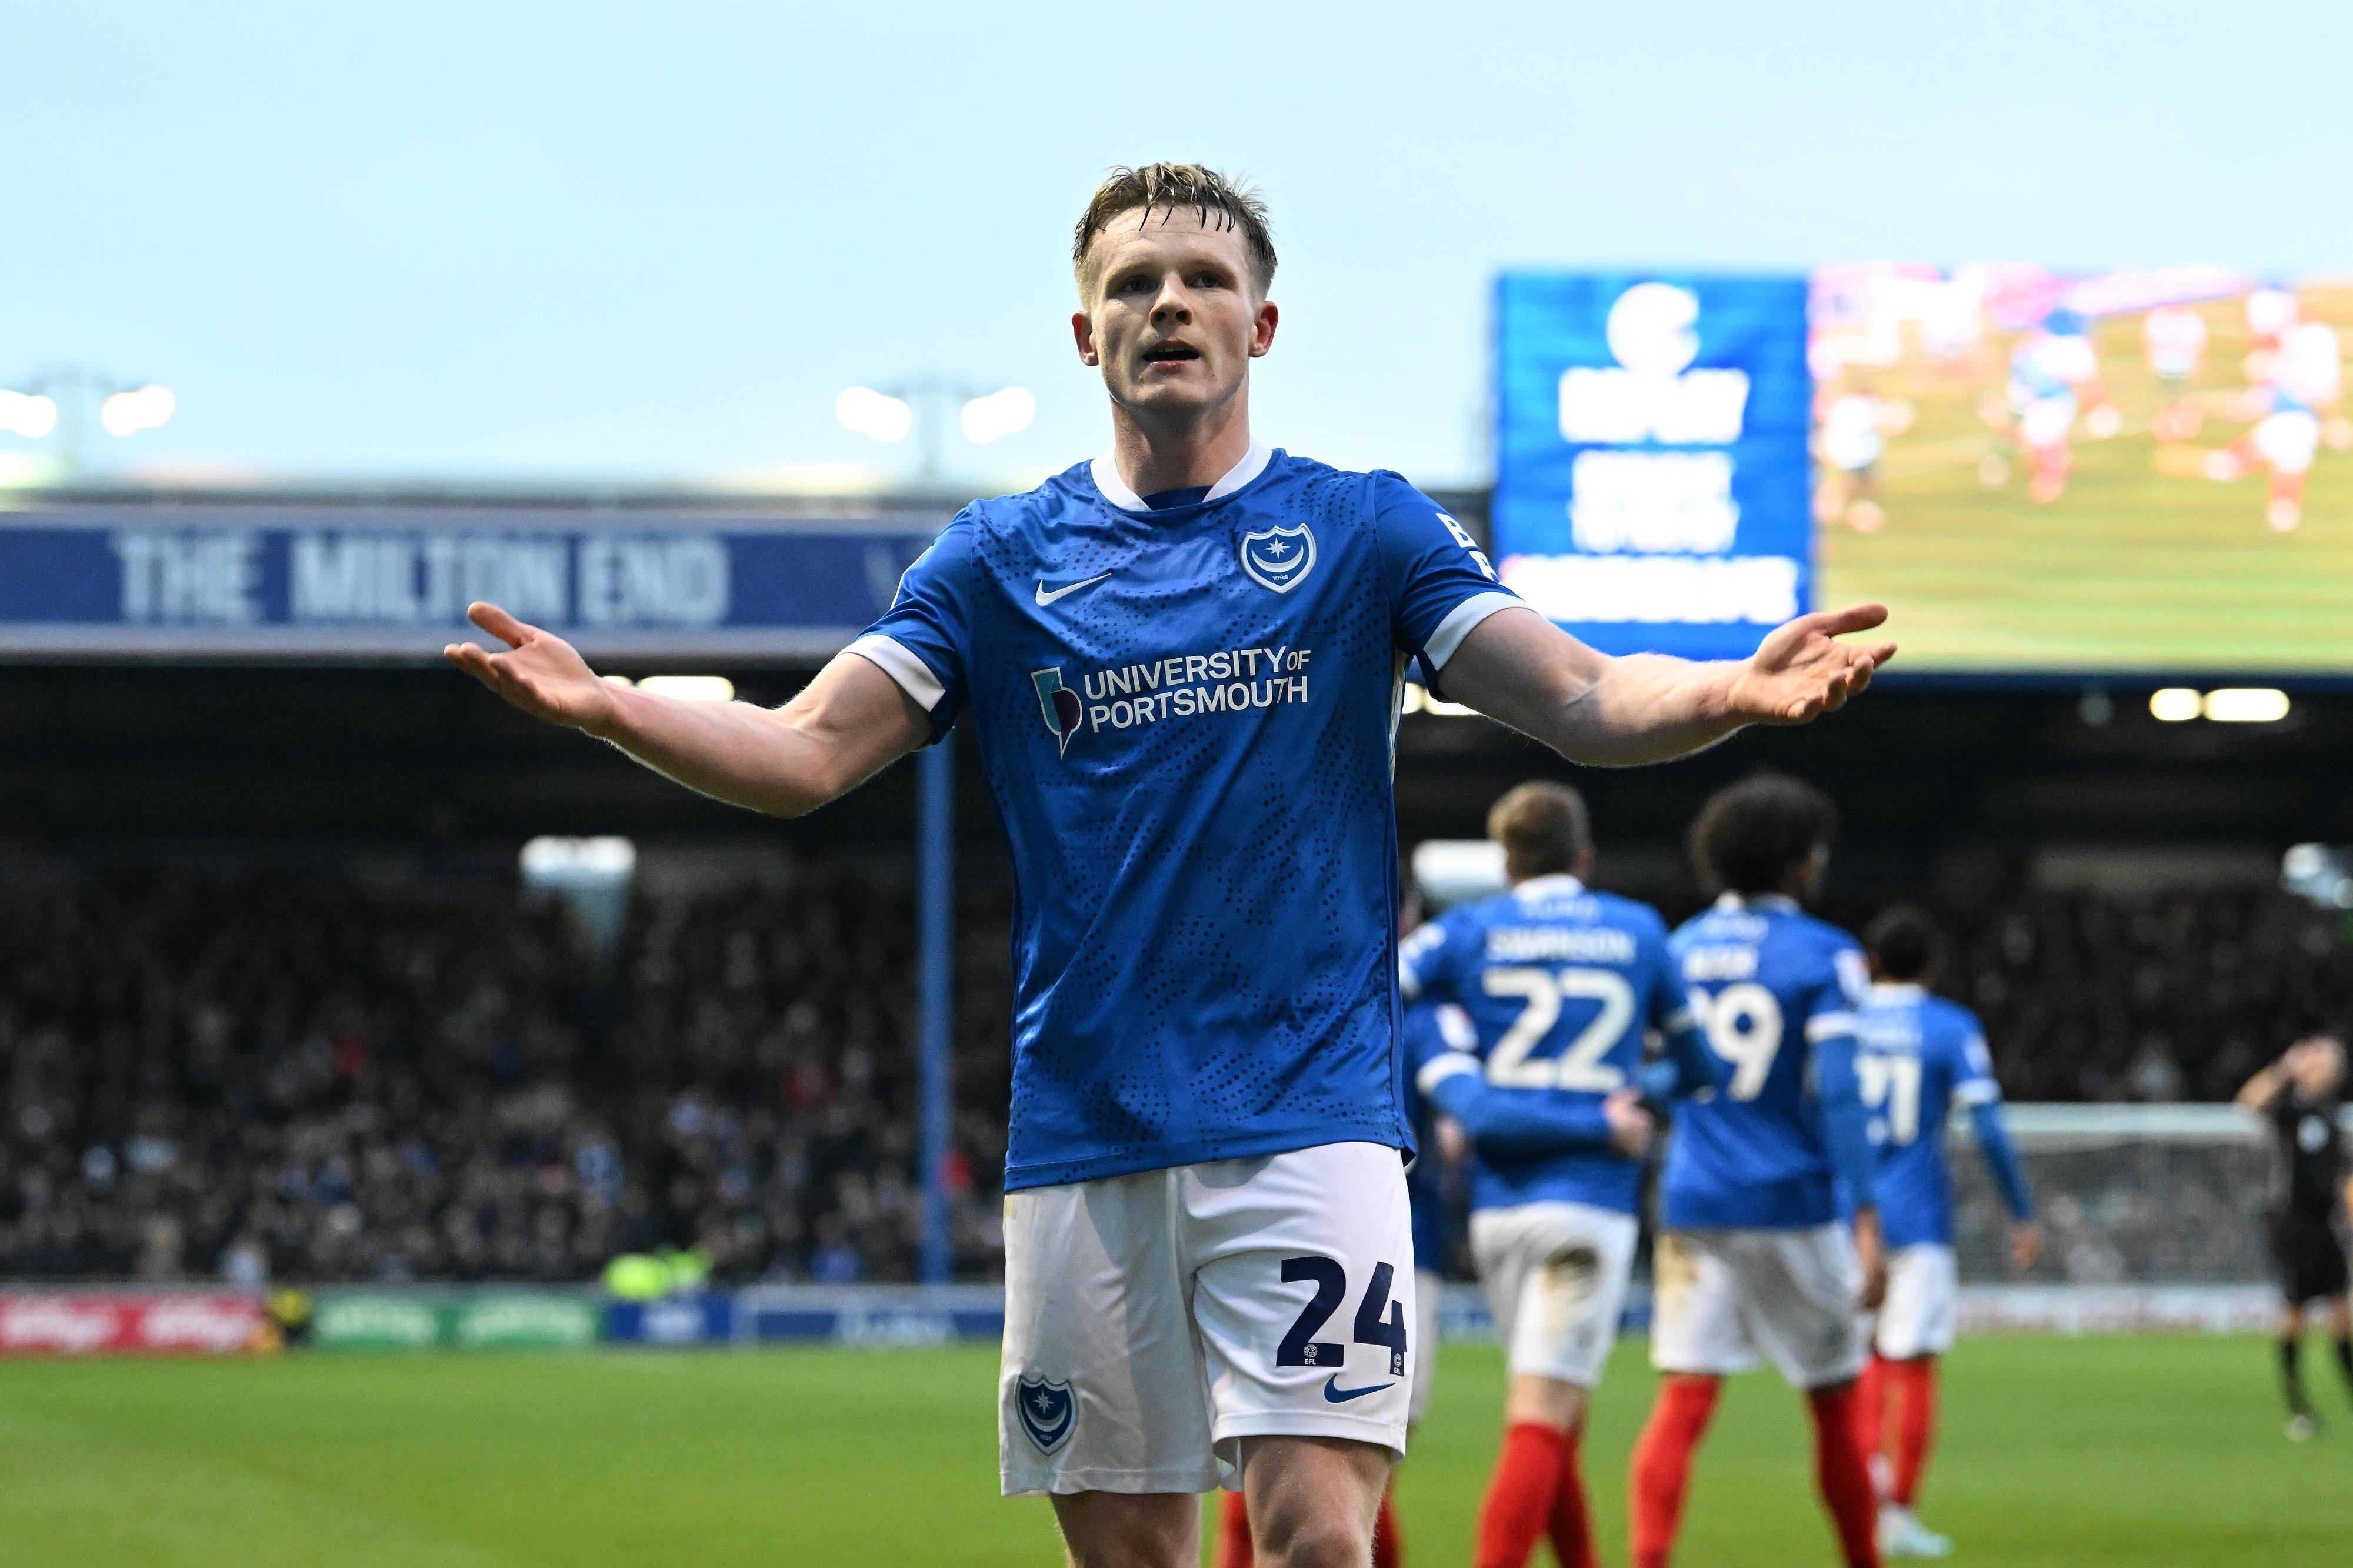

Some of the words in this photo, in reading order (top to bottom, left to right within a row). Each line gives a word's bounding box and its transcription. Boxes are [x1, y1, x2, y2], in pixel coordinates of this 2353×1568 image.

[115, 531, 262, 623] THE
[288, 531, 569, 623] MILTON
[579, 531, 733, 623] END
[1084, 646, 1287, 700] UNIVERSITY
[1287, 650, 1311, 672] OF
[1089, 676, 1308, 733] PORTSMOUTH
[1482, 966, 1635, 1093] 22
[1275, 1256, 1408, 1377] 24
